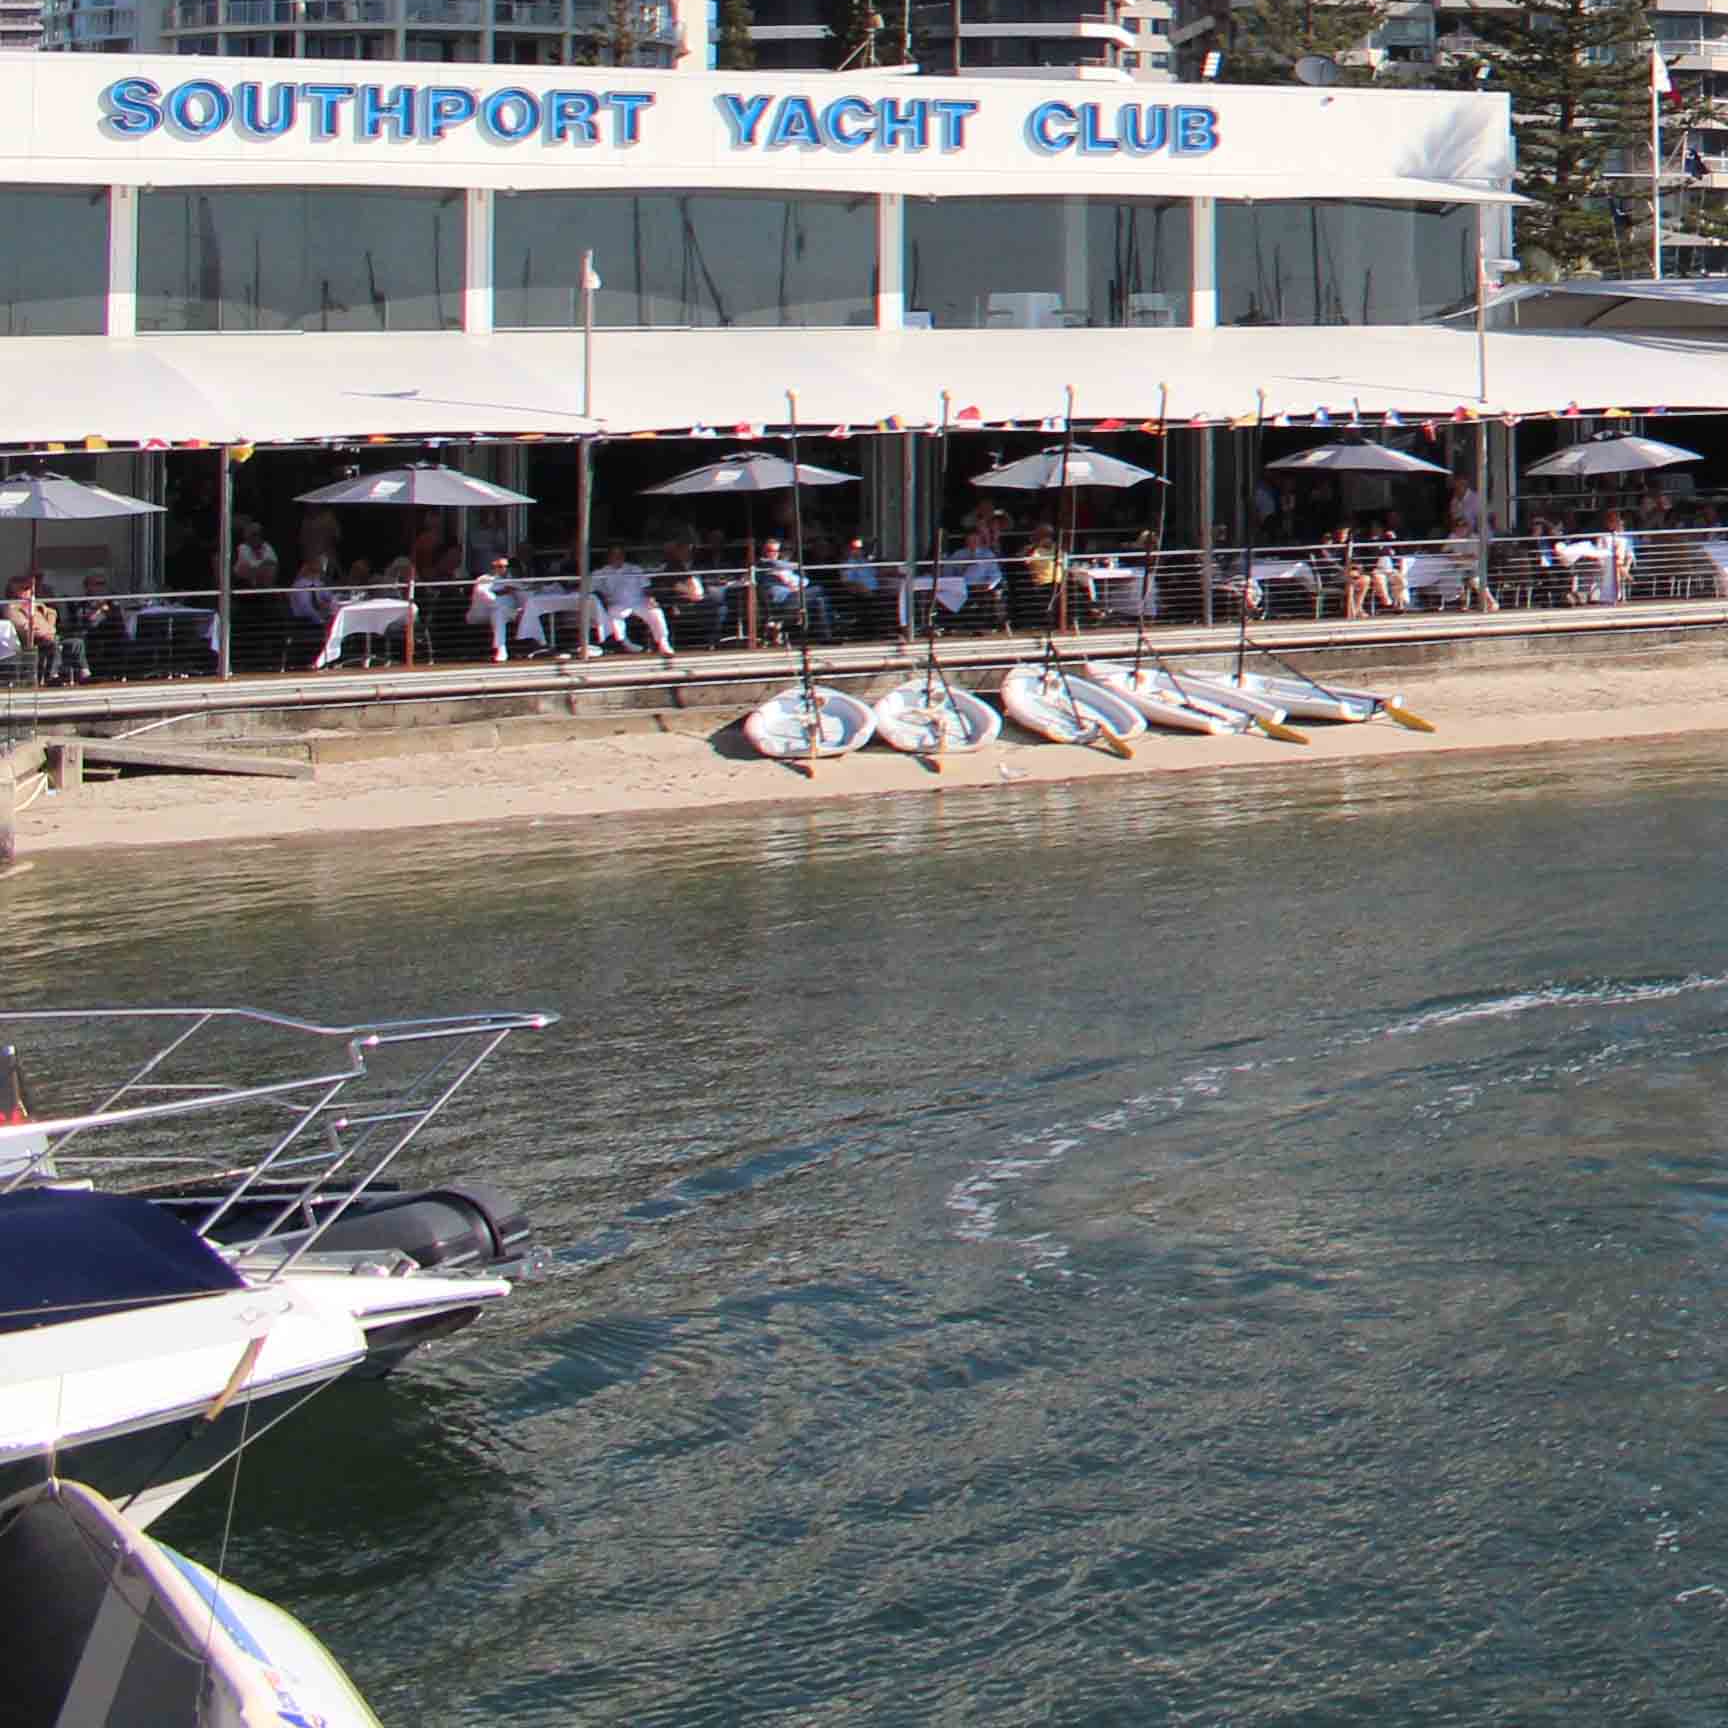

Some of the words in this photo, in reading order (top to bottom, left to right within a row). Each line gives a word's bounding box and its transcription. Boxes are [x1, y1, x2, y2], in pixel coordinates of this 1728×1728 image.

[100, 76, 657, 145] SOUTHPORT
[714, 93, 980, 153] YACHT
[1022, 100, 1221, 158] CLUB
